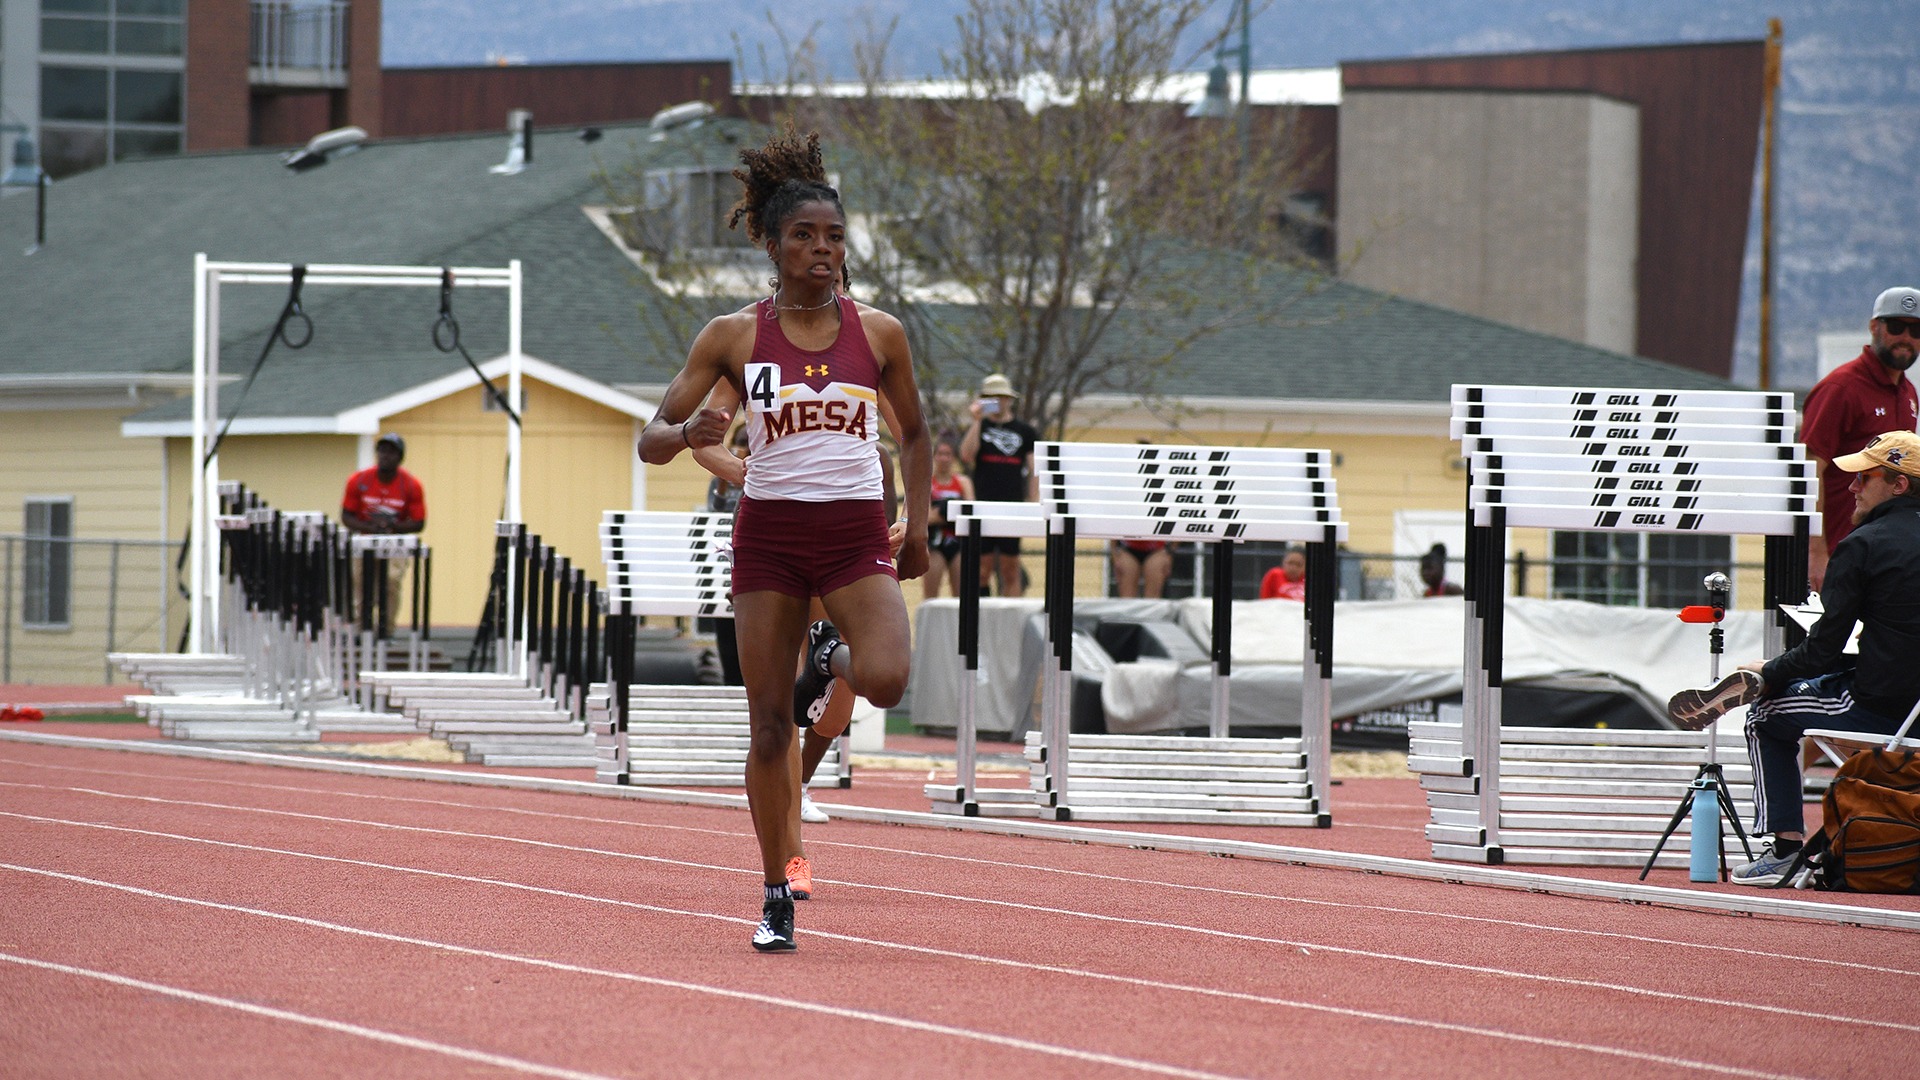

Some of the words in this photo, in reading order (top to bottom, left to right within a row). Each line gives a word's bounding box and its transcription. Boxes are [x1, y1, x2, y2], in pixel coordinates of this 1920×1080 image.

[751, 366, 775, 409] 4
[1606, 395, 1640, 405] GILL
[1608, 412, 1641, 422] GILL
[763, 400, 868, 445] MESA
[1606, 428, 1639, 439] GILL
[1168, 451, 1197, 460] GILL
[1617, 446, 1650, 456] GILL
[1169, 466, 1197, 475] GILL
[1627, 463, 1661, 473] GILL
[1174, 481, 1202, 490] GILL
[1630, 480, 1663, 491] GILL
[1175, 494, 1204, 504] GILL
[1627, 497, 1661, 507] GILL
[1178, 509, 1207, 518] GILL
[1632, 514, 1665, 525] GILL
[1185, 523, 1214, 533] GILL
[820, 640, 838, 676] CALV
